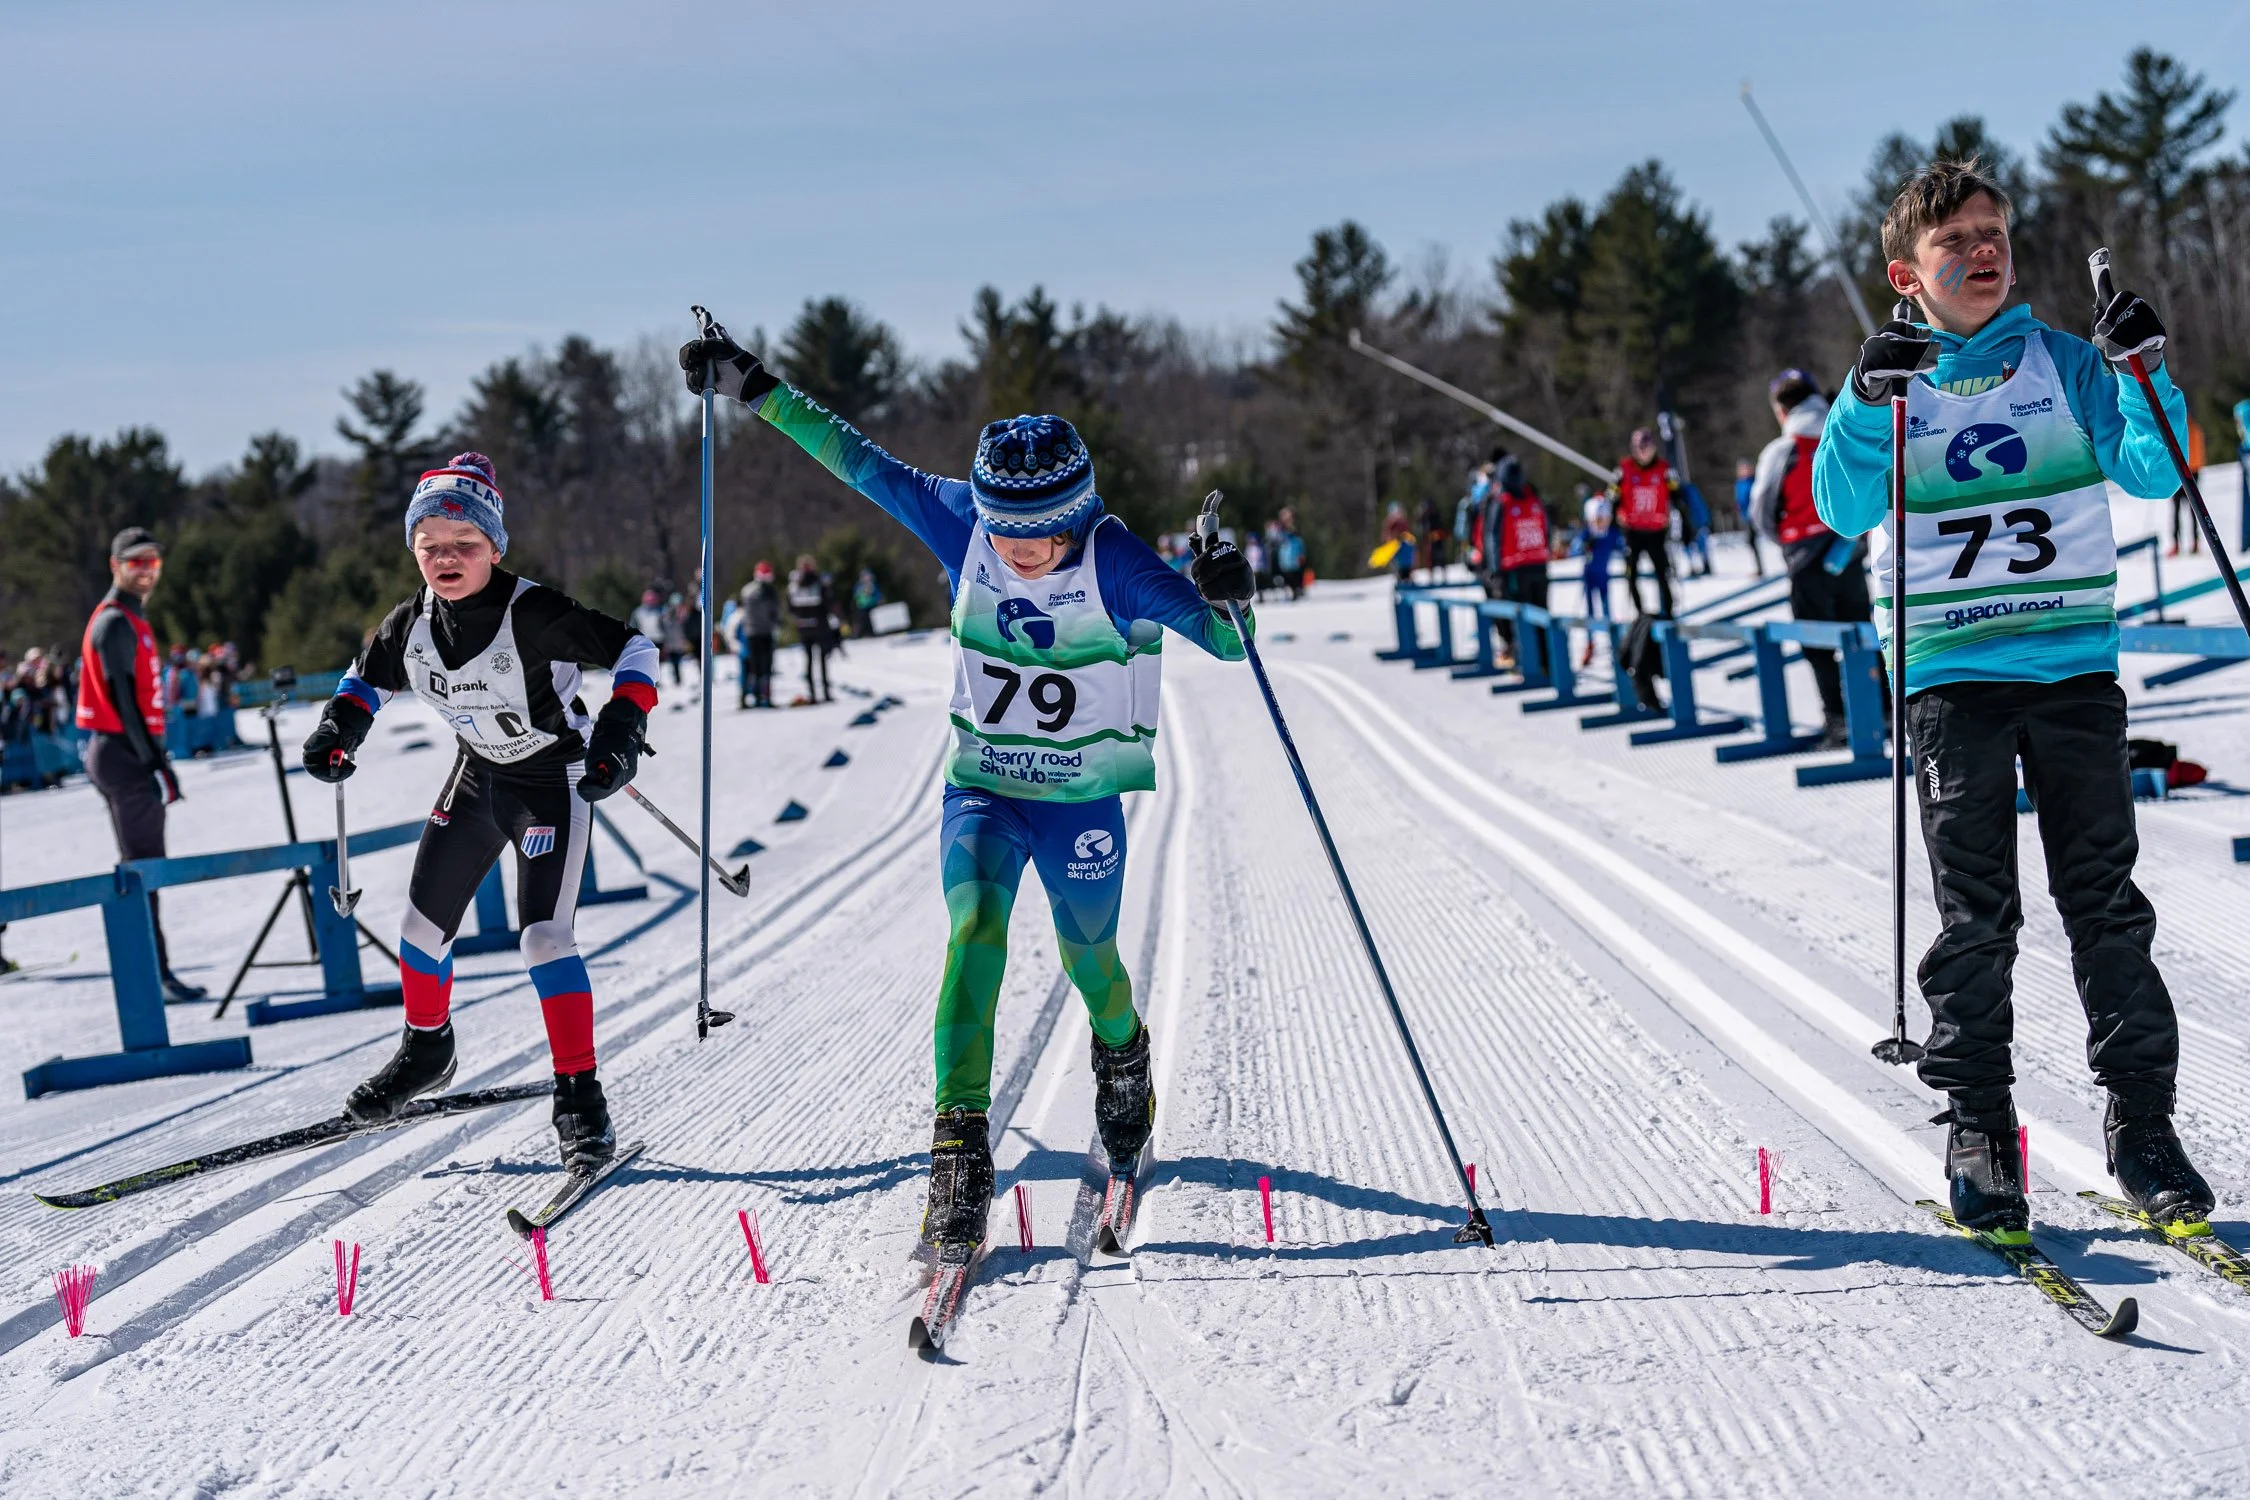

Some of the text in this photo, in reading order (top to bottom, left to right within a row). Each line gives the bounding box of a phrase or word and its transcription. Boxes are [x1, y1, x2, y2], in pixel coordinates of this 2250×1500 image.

[2116, 308, 2136, 325] wix
[1939, 375, 2004, 396] NIK
[2009, 400, 2041, 412] Friends
[2017, 407, 2039, 418] Quarry
[2038, 405, 2053, 413] Road
[1910, 427, 1947, 439] Recreation
[1937, 508, 2057, 580] 73
[430, 672, 488, 696] TD Bank
[982, 662, 1077, 733] 79
[490, 738, 528, 751] FESTIVAL
[1041, 751, 1083, 768] road
[1009, 768, 1046, 784] club
[1067, 861, 1101, 872] quarry
[1102, 849, 1119, 868] road
[1067, 869, 1106, 880] ski club
